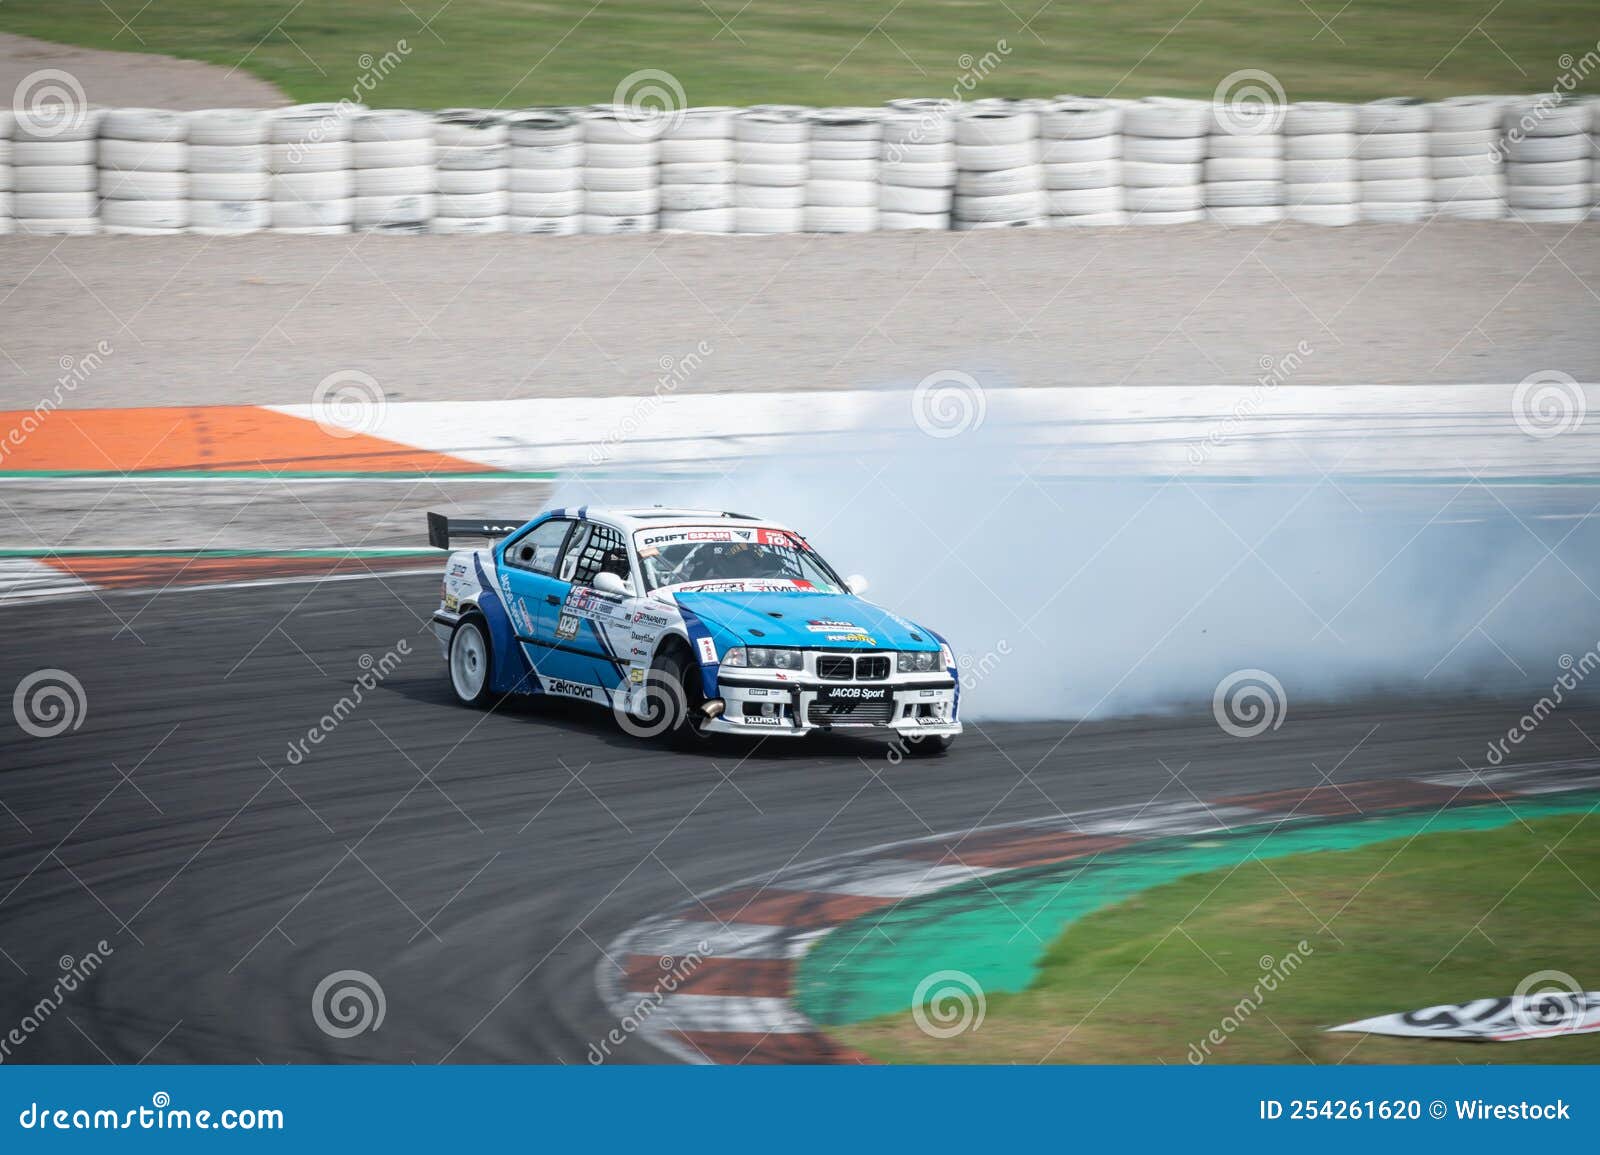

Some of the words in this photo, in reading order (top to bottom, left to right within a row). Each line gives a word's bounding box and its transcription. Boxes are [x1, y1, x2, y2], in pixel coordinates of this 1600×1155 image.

[644, 533, 687, 545] DRIFT
[688, 532, 730, 540] SPAIN
[828, 687, 861, 698] JACOB
[861, 687, 885, 700] Sport
